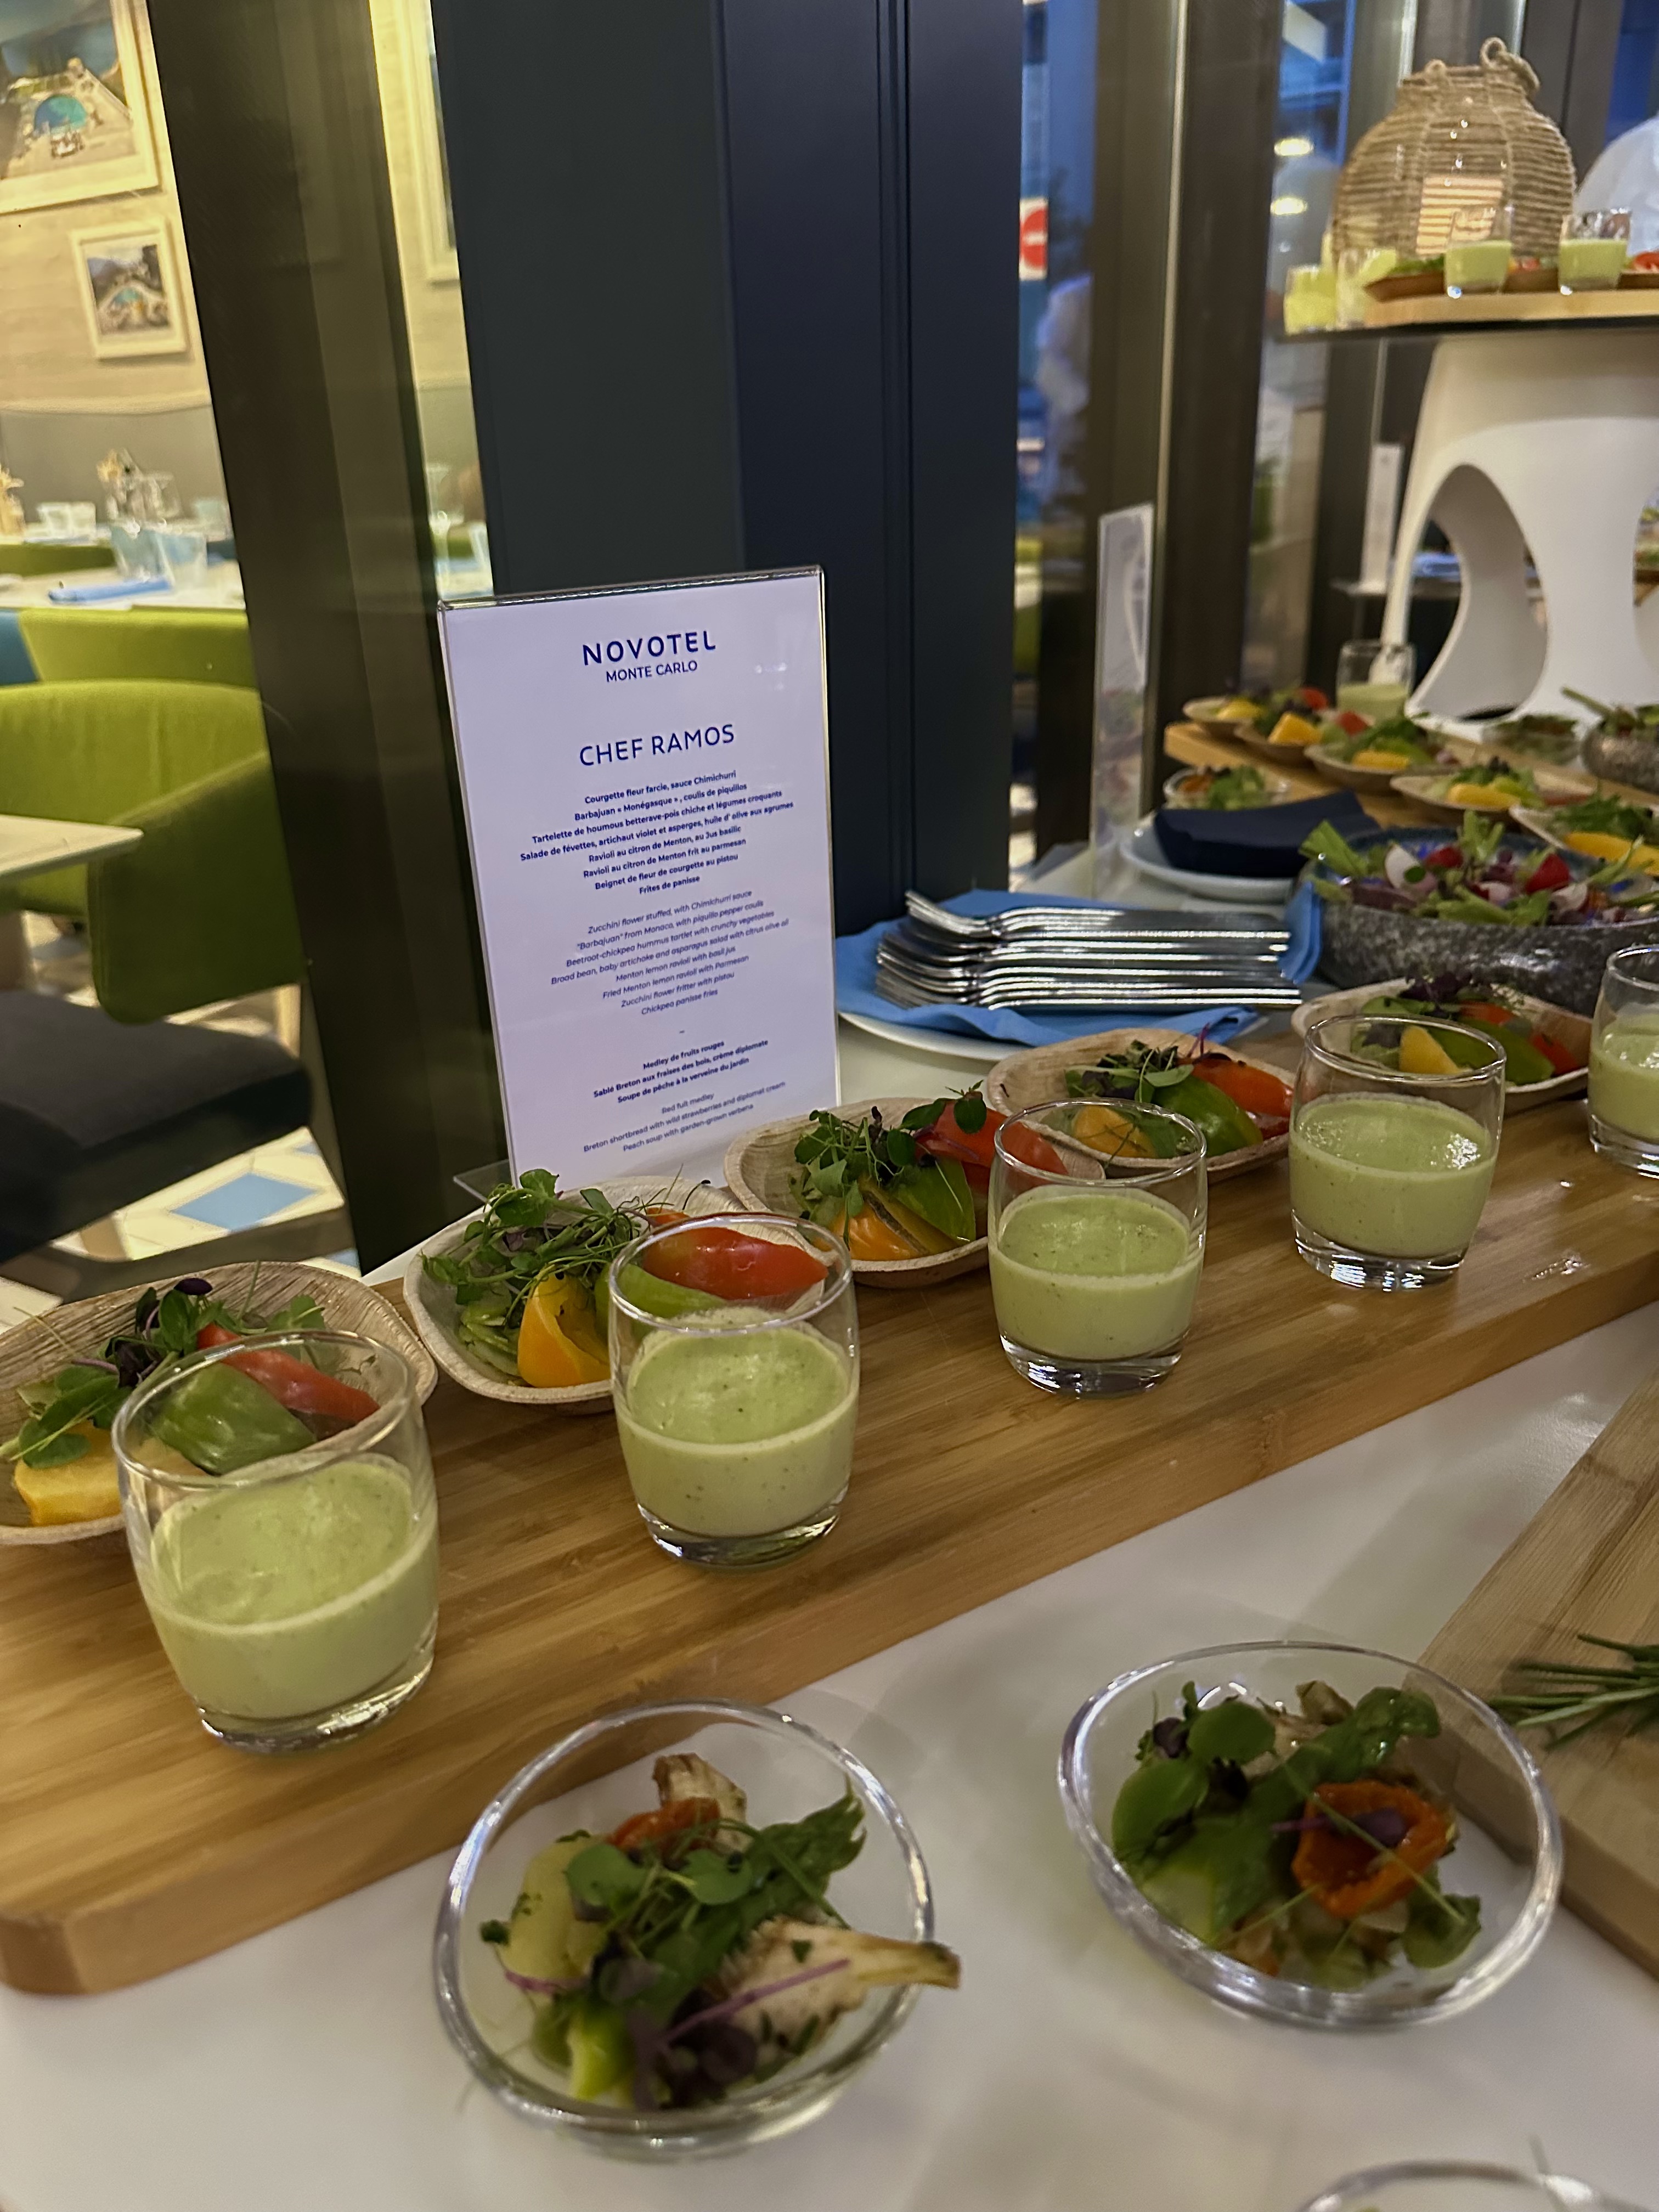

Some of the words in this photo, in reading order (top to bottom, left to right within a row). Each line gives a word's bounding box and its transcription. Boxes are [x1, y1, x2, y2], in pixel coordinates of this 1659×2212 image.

[582, 630, 715, 666] NOVOTEL
[606, 665, 652, 682] MONTE
[656, 660, 697, 675] CARLO
[579, 738, 642, 766] CHEF
[651, 724, 734, 755] RAMOS
[574, 808, 616, 821] Barbajuan
[623, 798, 672, 812] Monégasque
[684, 791, 705, 800] coulis
[717, 783, 747, 796] piquillos
[584, 792, 624, 804] Courgette
[626, 788, 644, 797] fleur
[646, 783, 669, 793] farcie,
[670, 780, 692, 789] sauce
[693, 770, 736, 785] Chimichurri
[520, 849, 549, 861] Salade
[550, 847, 561, 855] de
[599, 833, 634, 845] artichaut
[635, 828, 657, 838] violet
[668, 821, 703, 832] asperges,
[704, 816, 722, 825] huile
[764, 802, 793, 814] agrumes
[532, 831, 572, 843] Tartelette
[574, 827, 584, 836] de
[586, 821, 624, 834] houmous
[625, 809, 679, 826] betterave-pois
[681, 805, 705, 815] chiche
[715, 798, 746, 809] légumes
[747, 791, 782, 803] croquants
[583, 865, 610, 878] Ravioli
[623, 860, 645, 870] citron
[647, 856, 656, 865] de
[658, 851, 686, 862] Menton
[687, 848, 699, 856] frit
[711, 839, 746, 853] parmesan
[589, 850, 615, 862] Ravioli
[628, 845, 651, 854] citron
[663, 837, 693, 848] Menton,
[719, 826, 741, 836] basilic
[595, 877, 625, 890] Beignet
[638, 872, 656, 881] fleur
[669, 861, 704, 874] courgette
[716, 854, 738, 865] pistou
[639, 885, 660, 894] Frites
[673, 876, 700, 888] panisse
[588, 921, 620, 934] Zucchini
[622, 916, 644, 926] flower
[674, 904, 690, 914] with
[691, 894, 731, 910] Chimichurri
[732, 890, 752, 900] sauce
[624, 930, 642, 939] from
[675, 917, 691, 927] with
[719, 906, 743, 918] pepper
[744, 900, 764, 910] coulis
[551, 972, 575, 985] Broad
[576, 968, 597, 978] bean,
[599, 963, 618, 973] baby
[619, 953, 654, 967] artichoke
[655, 949, 670, 958] and
[671, 940, 708, 955] asparagus
[709, 934, 729, 945] salad
[729, 930, 744, 939] with
[745, 926, 764, 936] citrus
[566, 945, 635, 967] Beetroot-chickpea
[637, 937, 669, 950] hummus
[693, 926, 709, 936] with
[710, 920, 738, 932] crunchy
[738, 911, 774, 924] vegetables
[602, 988, 622, 998] Fried
[623, 981, 651, 994] Menton
[652, 975, 675, 986] lemon
[676, 968, 697, 979] ravioli
[698, 964, 714, 974] with
[715, 955, 749, 969] Parmesan
[616, 970, 644, 981] Menton
[645, 964, 668, 974] lemon
[669, 956, 691, 968] ravioli
[692, 952, 707, 962] with
[708, 947, 725, 958] basil
[725, 946, 736, 956] jus
[621, 994, 652, 1008] Zucchini
[653, 988, 675, 998] flower
[676, 982, 696, 992] fritter
[697, 977, 713, 987] with
[713, 972, 735, 984] pistou
[641, 1001, 674, 1015] Chickpea
[675, 994, 702, 1007] panisse
[703, 989, 718, 998] fries
[594, 1086, 614, 1098] Sablé
[616, 1079, 641, 1091] Breton
[656, 1067, 680, 1078] fraises
[735, 1040, 768, 1054] diplomate
[643, 1058, 669, 1069] Medley
[680, 1048, 699, 1058] fruits
[701, 1041, 725, 1052] rouges
[618, 1092, 640, 1103] Soupe
[689, 1067, 719, 1081] verveine
[729, 1058, 749, 1070] jardin
